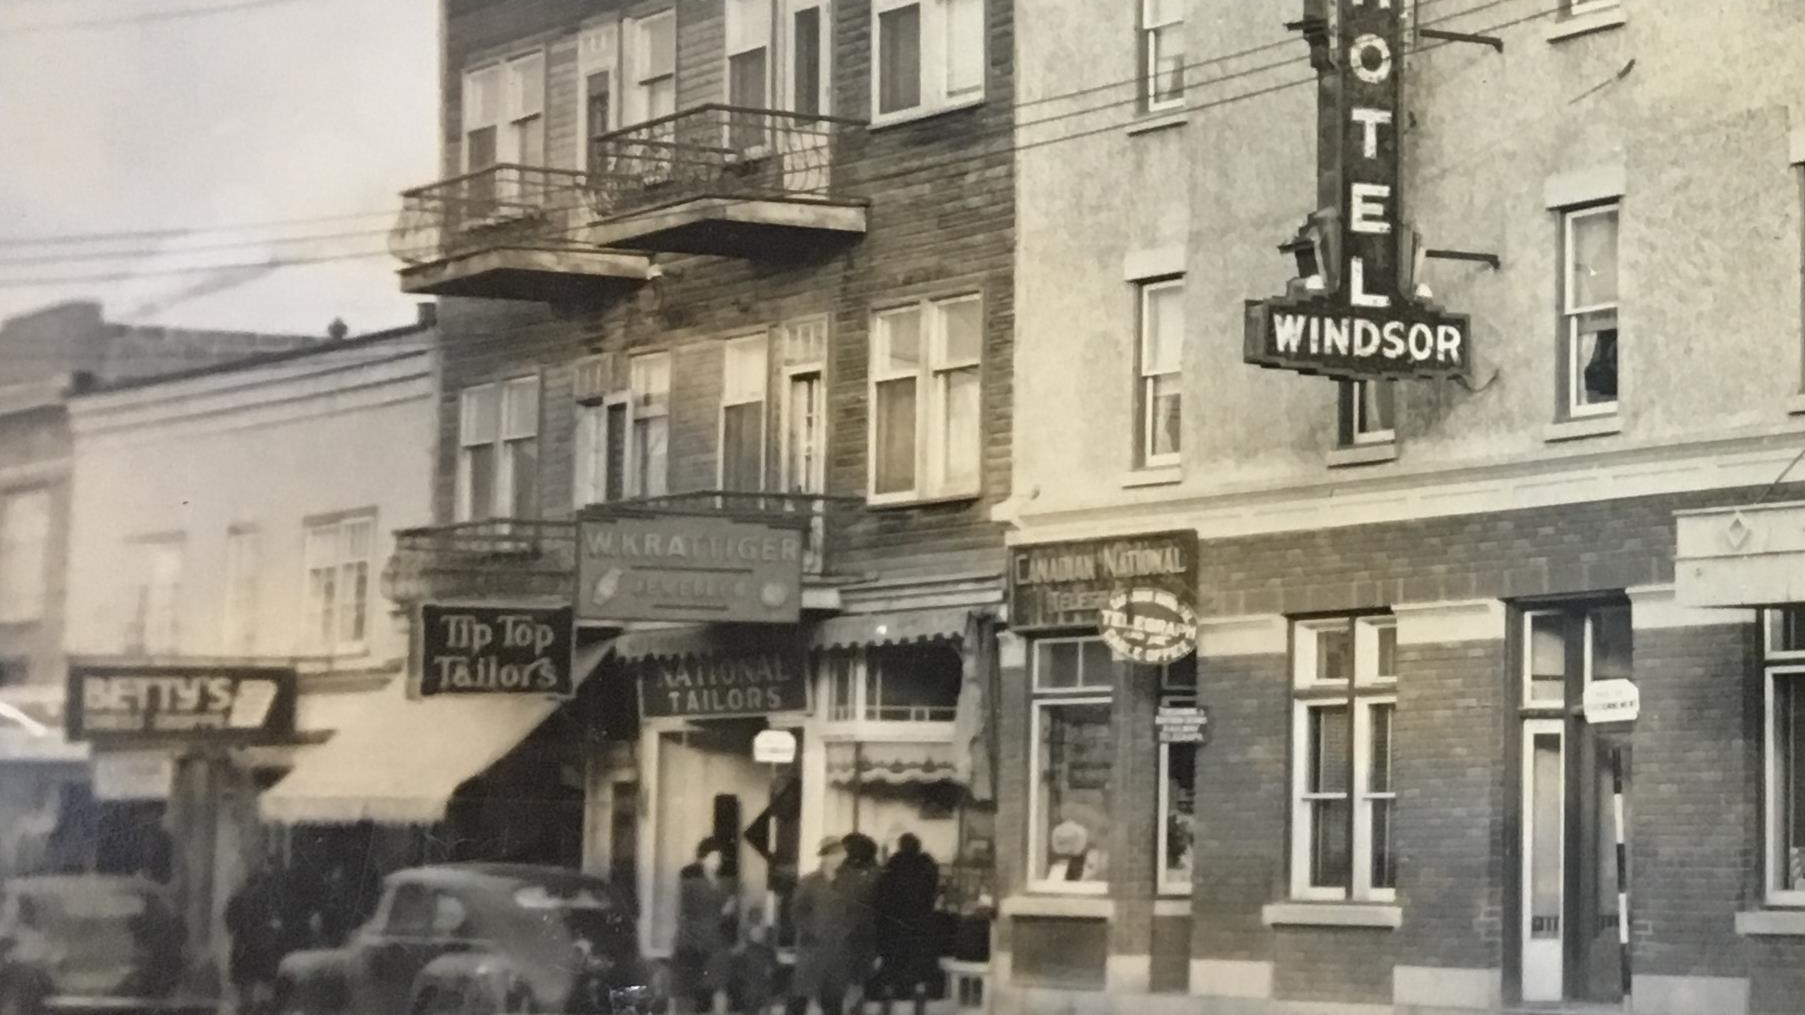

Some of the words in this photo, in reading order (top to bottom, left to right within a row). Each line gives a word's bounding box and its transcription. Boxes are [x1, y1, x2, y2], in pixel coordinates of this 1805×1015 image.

[1273, 313, 1462, 365] WINDSOR
[1015, 552, 1097, 585] CANADIAN
[1102, 542, 1188, 579] NATIONAL
[496, 615, 555, 657] Top
[433, 655, 558, 689] Tailors
[667, 686, 783, 713] TAILORS
